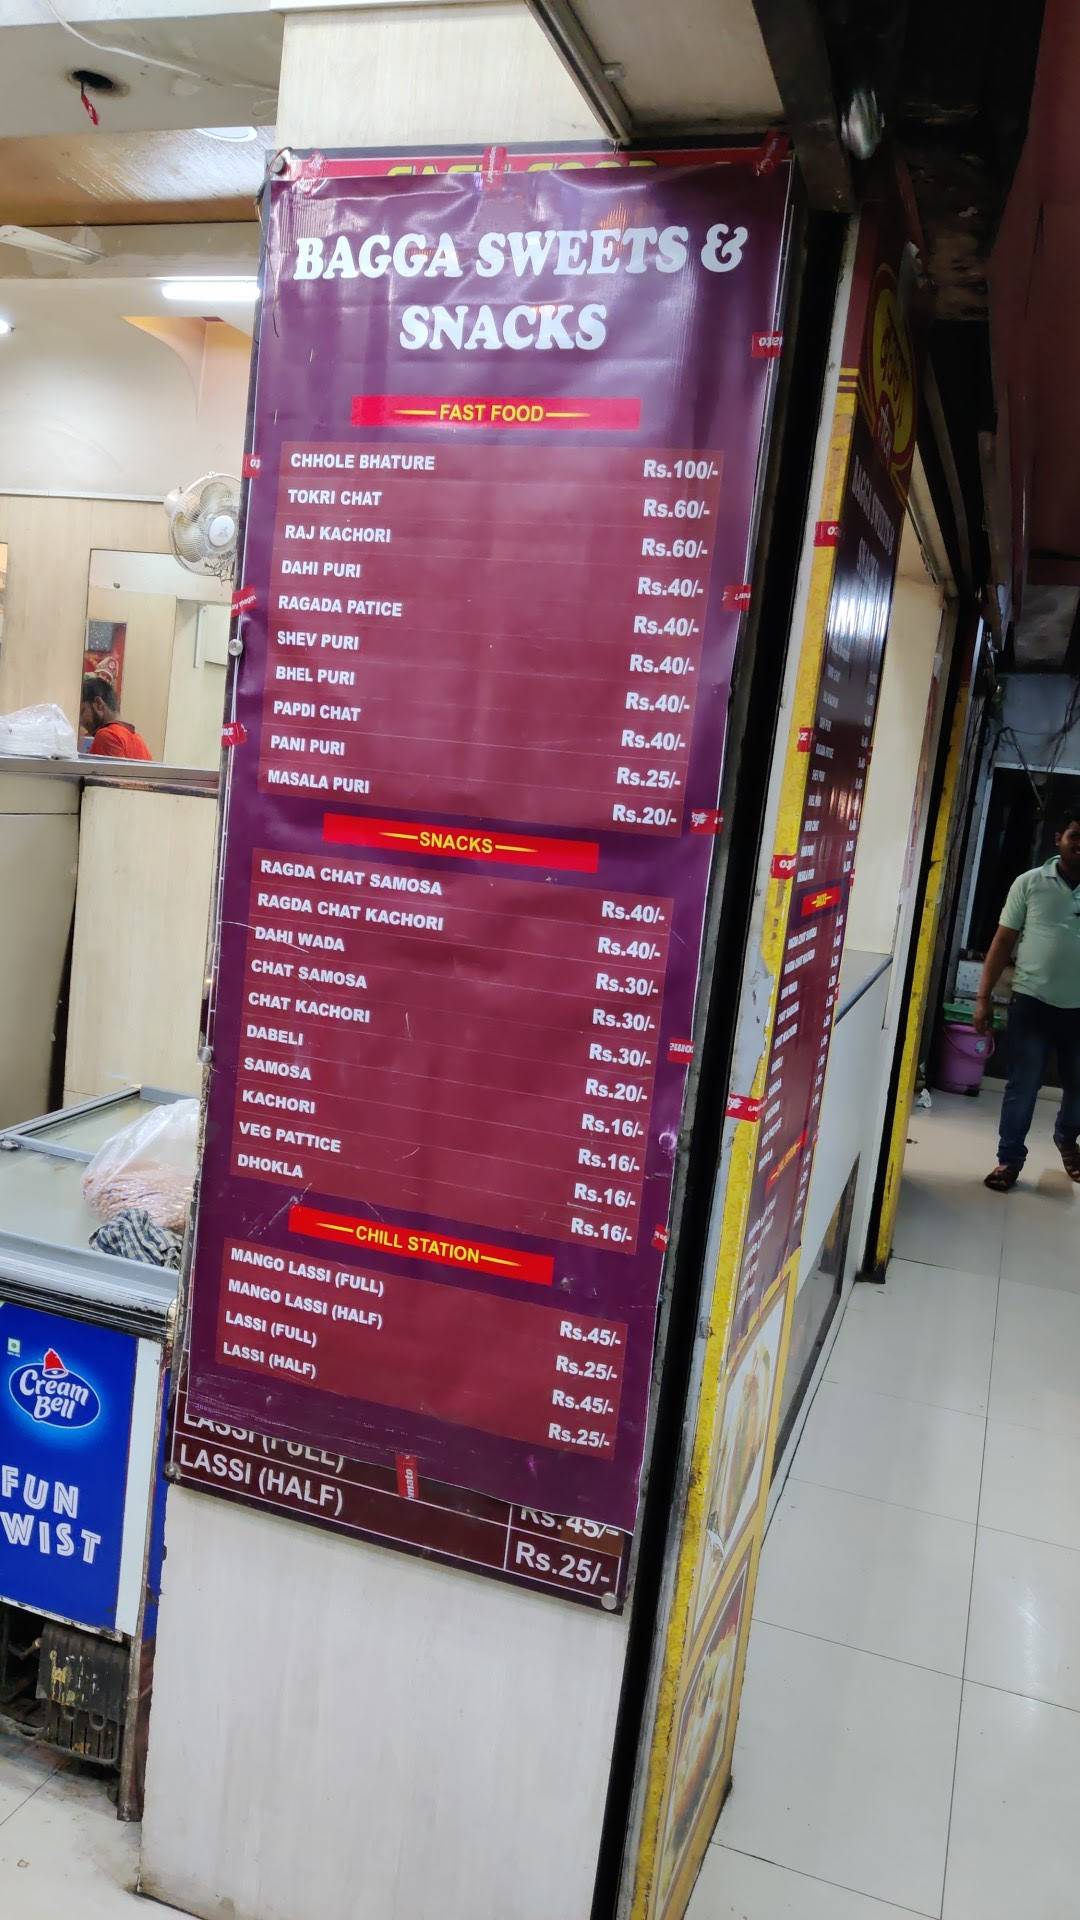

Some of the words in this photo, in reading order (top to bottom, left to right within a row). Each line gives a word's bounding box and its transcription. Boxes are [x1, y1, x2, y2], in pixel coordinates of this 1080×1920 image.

[292, 234, 464, 281] BAGGA
[475, 227, 689, 278] SWEETS
[700, 223, 749, 273] &
[399, 303, 608, 350] SNACKS
[439, 403, 486, 421] FAST
[490, 404, 544, 422] FOOD
[290, 452, 355, 469] CHHOLE
[359, 454, 435, 471] BHATURE
[643, 458, 719, 480] Rs.100/-
[287, 488, 336, 505] TOKRI
[340, 490, 383, 506] CHAT
[643, 498, 710, 519] Rs.60/-
[284, 524, 315, 540] RAJ
[319, 525, 391, 543] KACHORI
[641, 537, 708, 559] Rs.60/-
[281, 559, 319, 576] DAHI
[323, 561, 361, 578] PURI
[637, 576, 704, 598] Rs.40/-
[278, 595, 343, 613] RAGADA
[346, 599, 403, 617] PATICE
[633, 615, 699, 637] Rs.40/-
[277, 630, 318, 647] SHEV
[320, 633, 359, 651] PURI
[275, 665, 314, 682] BHEL
[317, 668, 355, 686] PURI
[629, 653, 695, 676] Rs.40/-
[273, 700, 316, 718] PAPDI
[319, 704, 362, 722] CHAT
[625, 691, 691, 714] Rs.40/-
[270, 734, 306, 752] PANI
[309, 739, 345, 756] PURI
[621, 729, 686, 751] Rs.40/-
[267, 769, 329, 790] MASALA
[332, 776, 370, 794] PURI
[616, 766, 681, 789] Rs.25/-
[612, 803, 677, 826] Rs.20/-
[419, 831, 493, 854] SNACKS
[260, 859, 316, 880] RAGDA
[320, 867, 366, 886] CHAT
[369, 873, 443, 896] SAMOSA
[257, 892, 313, 913] RAGDA
[317, 901, 362, 920] CHAT
[365, 907, 444, 931] KACHORI
[601, 900, 665, 924] Rs.40/-
[254, 926, 293, 945] DAHI
[297, 932, 345, 953] WADA
[597, 936, 661, 960] Rs.40/-
[251, 959, 295, 978] CHAT
[297, 966, 368, 989] SAMOSA
[595, 972, 659, 997] Rs.30/-
[248, 991, 292, 1011] CHAT
[295, 999, 370, 1023] KACHORI
[592, 1008, 656, 1032] Rs.30/-
[246, 1024, 304, 1046] DABELI
[589, 1042, 652, 1067] Rs.30/-
[243, 1057, 312, 1081] SAMOSA
[242, 1089, 316, 1114] KACHORI
[585, 1078, 648, 1103] Rs.20/-
[239, 1121, 272, 1139] VEG
[275, 1128, 342, 1153] PATTICE
[581, 1113, 644, 1138] Rs.16/-
[237, 1153, 303, 1179] DHOKLA
[578, 1148, 640, 1173] Rs.16/-
[574, 1182, 636, 1208] Rs.16/-
[570, 1217, 633, 1243] Rs.16/-
[355, 1225, 403, 1249] CHILL
[407, 1236, 480, 1264] STATION
[230, 1247, 285, 1272] MANGO
[288, 1260, 331, 1283] LASSI
[334, 1271, 384, 1298] (FULL)
[228, 1278, 282, 1304] MANGO
[284, 1292, 328, 1316] LASSI
[331, 1304, 383, 1330] (HALF)
[225, 1310, 267, 1333] LASSI
[270, 1322, 317, 1348] (FULL)
[559, 1320, 621, 1347] Rs.45/-
[223, 1341, 265, 1363] LASSI
[268, 1353, 317, 1380] (HALF)
[555, 1354, 618, 1381] Rs.25/-
[19, 1368, 89, 1406] Cream
[32, 1395, 77, 1421] Bell
[552, 1389, 614, 1415] Rs.45/-
[183, 1413, 256, 1444] LASSI
[548, 1422, 610, 1448] Rs.25/-
[1, 1464, 79, 1519] FUN
[179, 1443, 252, 1484] LASSI
[258, 1466, 344, 1517] (HALF)
[515, 1540, 610, 1585] Rs.25/-
